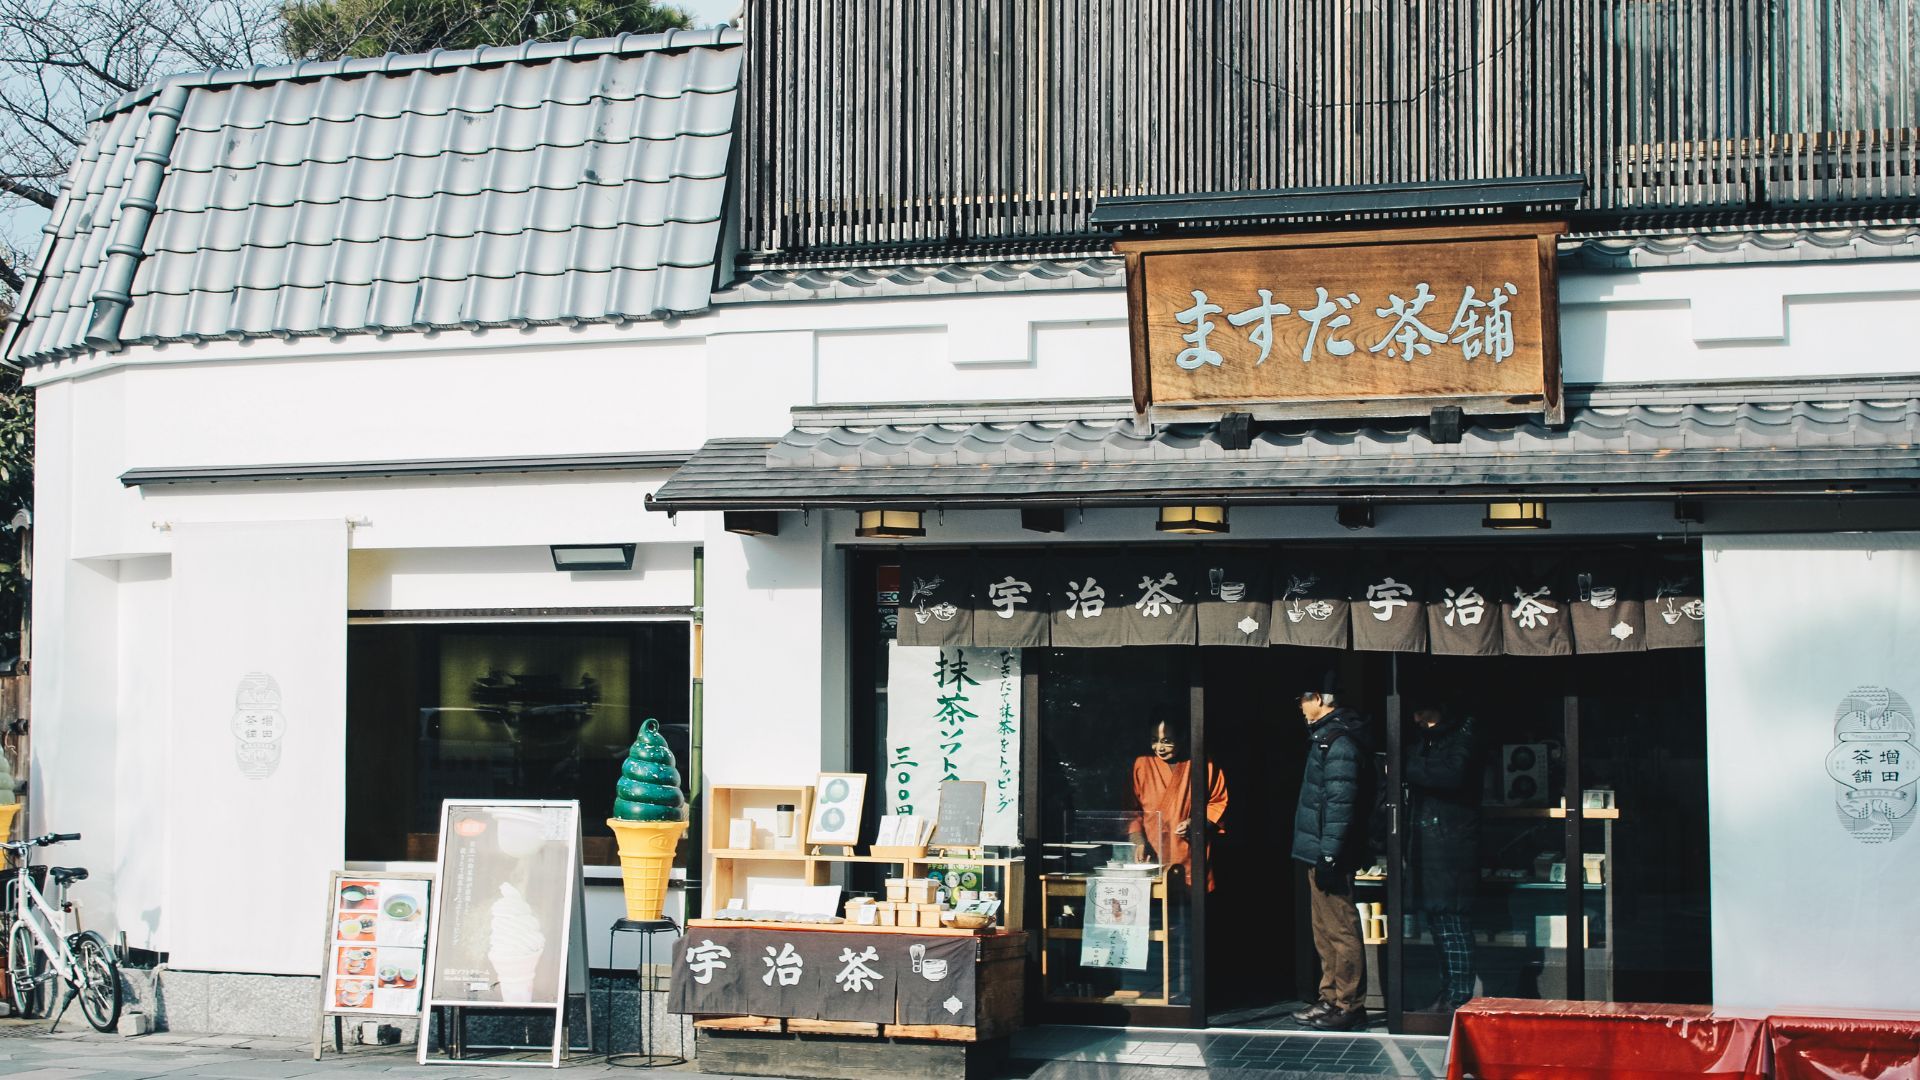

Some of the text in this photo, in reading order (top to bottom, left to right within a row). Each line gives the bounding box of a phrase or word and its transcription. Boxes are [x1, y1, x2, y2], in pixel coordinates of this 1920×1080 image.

[987, 571, 1184, 619] 宇治茶
[1365, 576, 1559, 630] 宇治茶
[685, 939, 885, 993] 宇治茶
